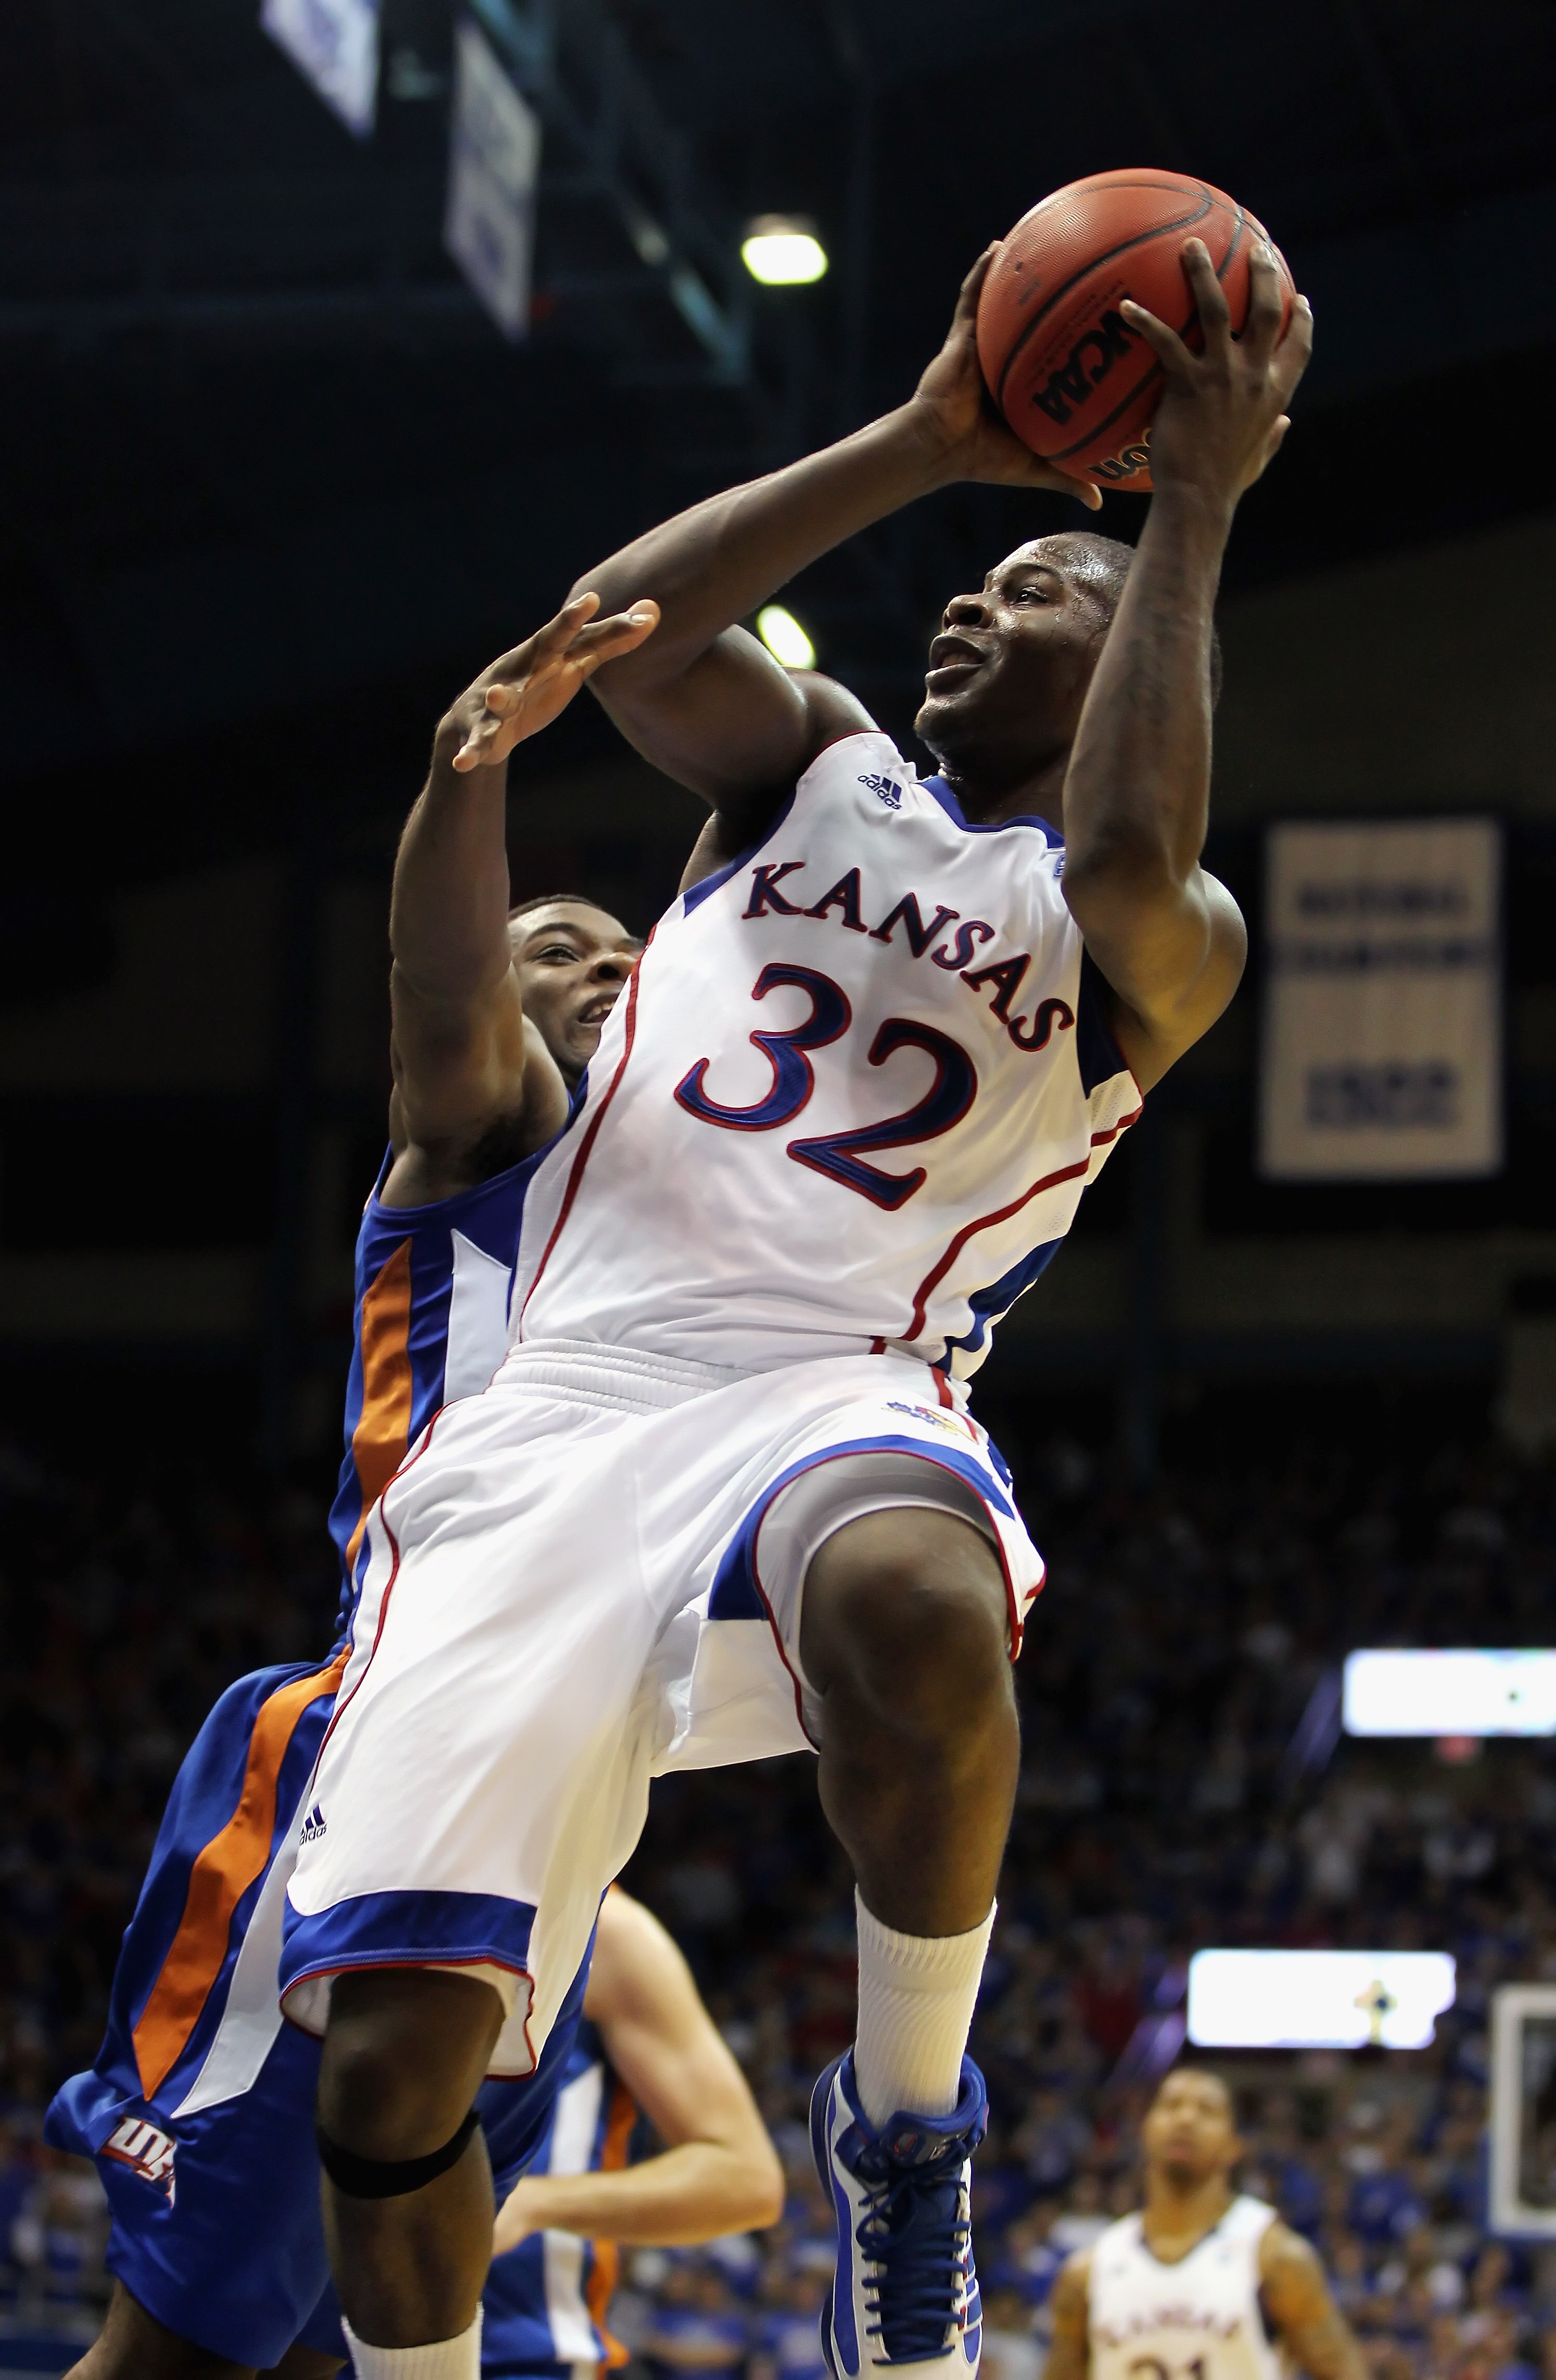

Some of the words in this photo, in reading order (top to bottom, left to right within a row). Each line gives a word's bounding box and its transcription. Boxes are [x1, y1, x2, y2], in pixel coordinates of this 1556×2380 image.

[858, 775, 902, 810] adidas
[742, 861, 1075, 1052] KANSAS
[673, 962, 978, 1212] 32
